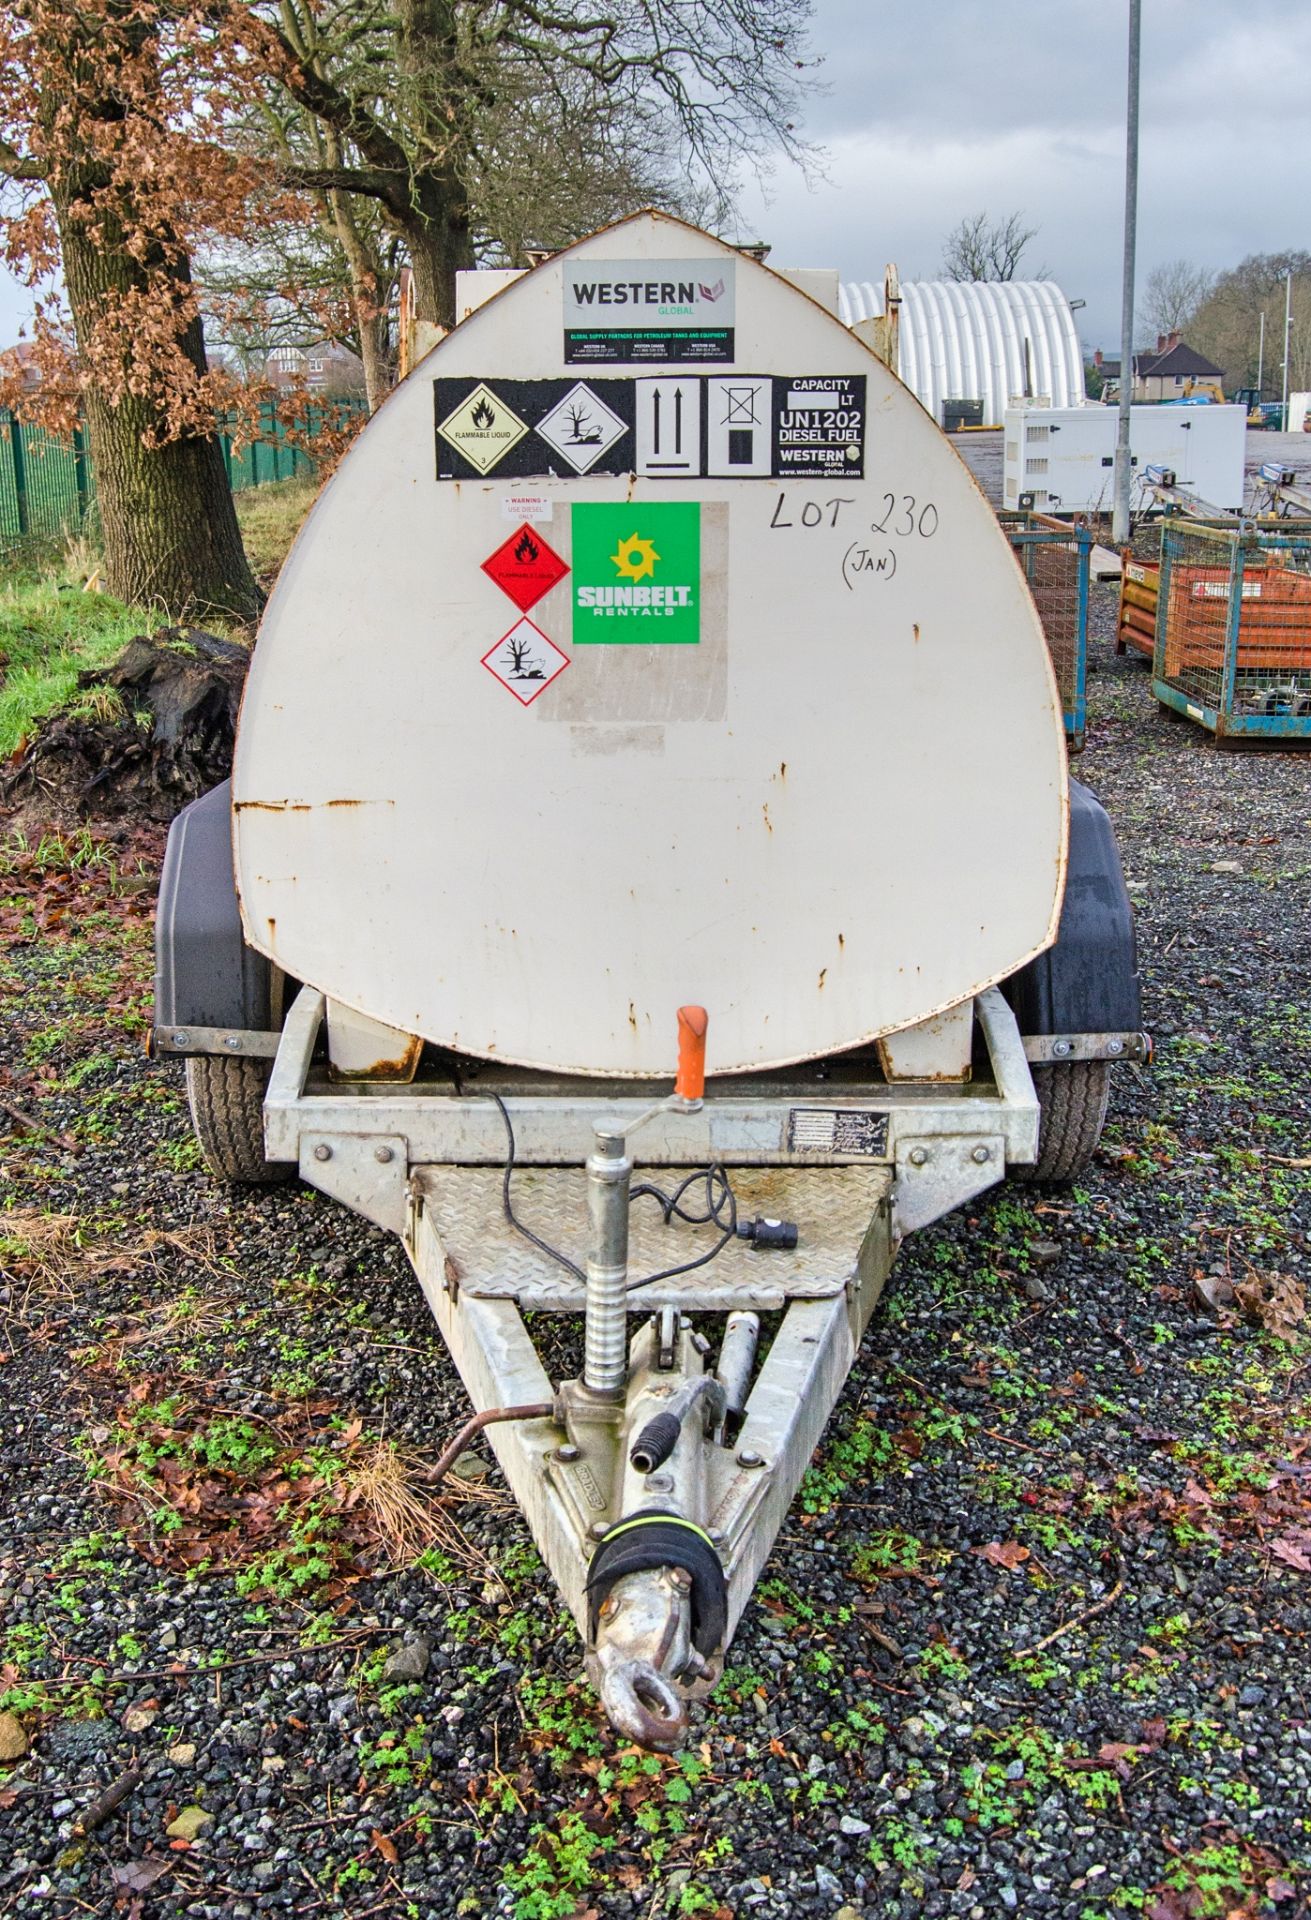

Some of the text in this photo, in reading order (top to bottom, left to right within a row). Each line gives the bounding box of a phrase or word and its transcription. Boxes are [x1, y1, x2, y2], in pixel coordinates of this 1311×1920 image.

[572, 282, 694, 304] WESTERN
[658, 306, 694, 315] GLOBAL
[792, 380, 850, 390] CAPACITY
[841, 395, 854, 405] LT
[780, 411, 860, 428] UN1202
[779, 429, 861, 441] DIESEL FUEL
[780, 449, 845, 461] WESTERN
[770, 492, 938, 537] LOT 230
[842, 541, 896, 590] (JAN)
[577, 586, 691, 607] SUNBELT
[593, 607, 674, 616] RENTALS
[576, 1465, 605, 1508] BRADLEY
